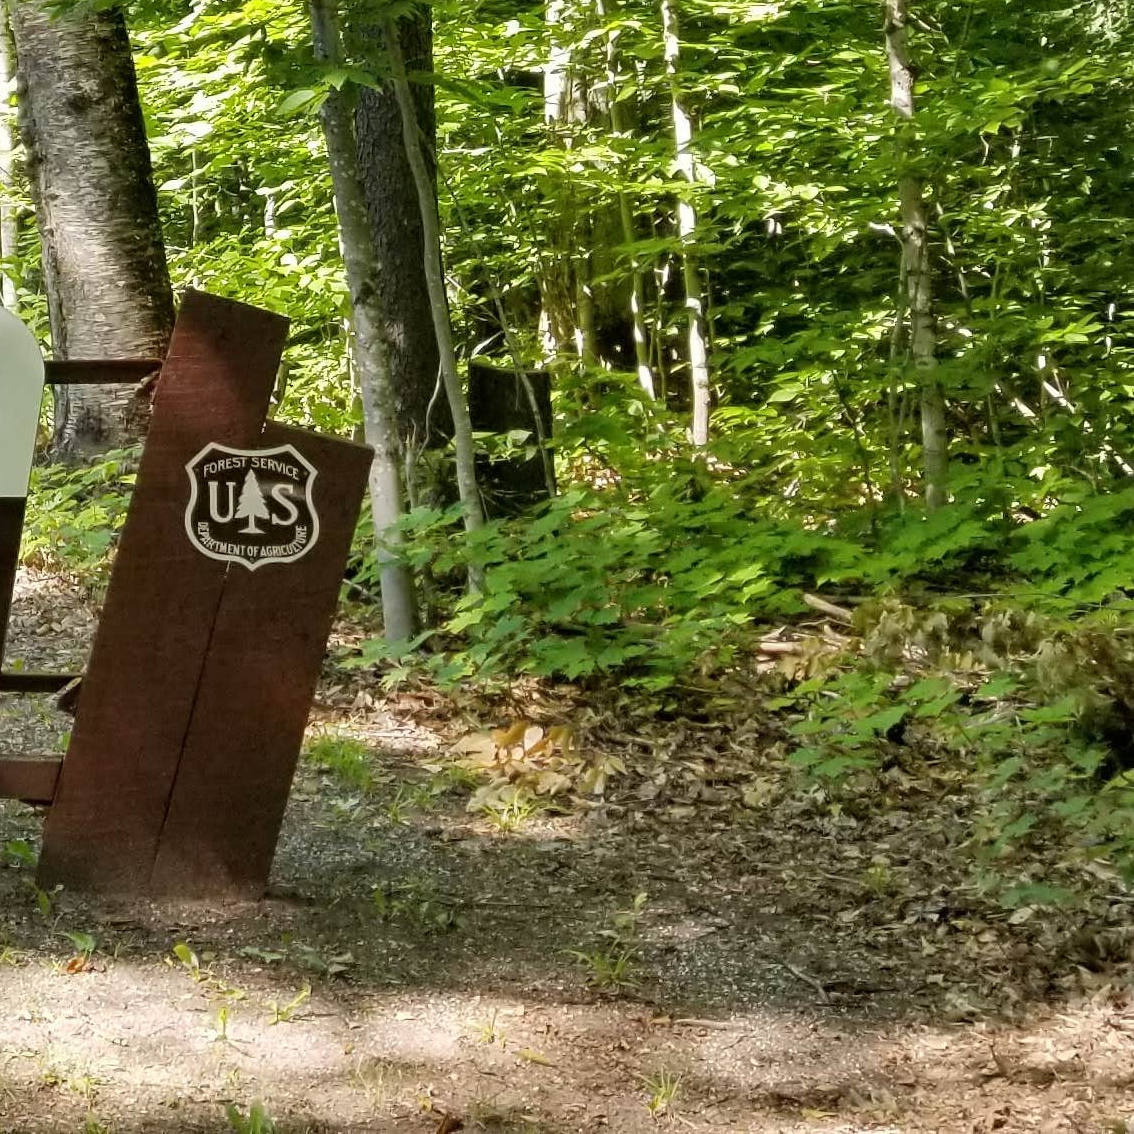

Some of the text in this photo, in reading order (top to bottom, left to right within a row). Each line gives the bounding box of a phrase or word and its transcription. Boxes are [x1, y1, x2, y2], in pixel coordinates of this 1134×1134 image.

[203, 457, 299, 480] FOREST SERVICE
[197, 521, 306, 557] DEPARTMENT OF AGRICULTURE
